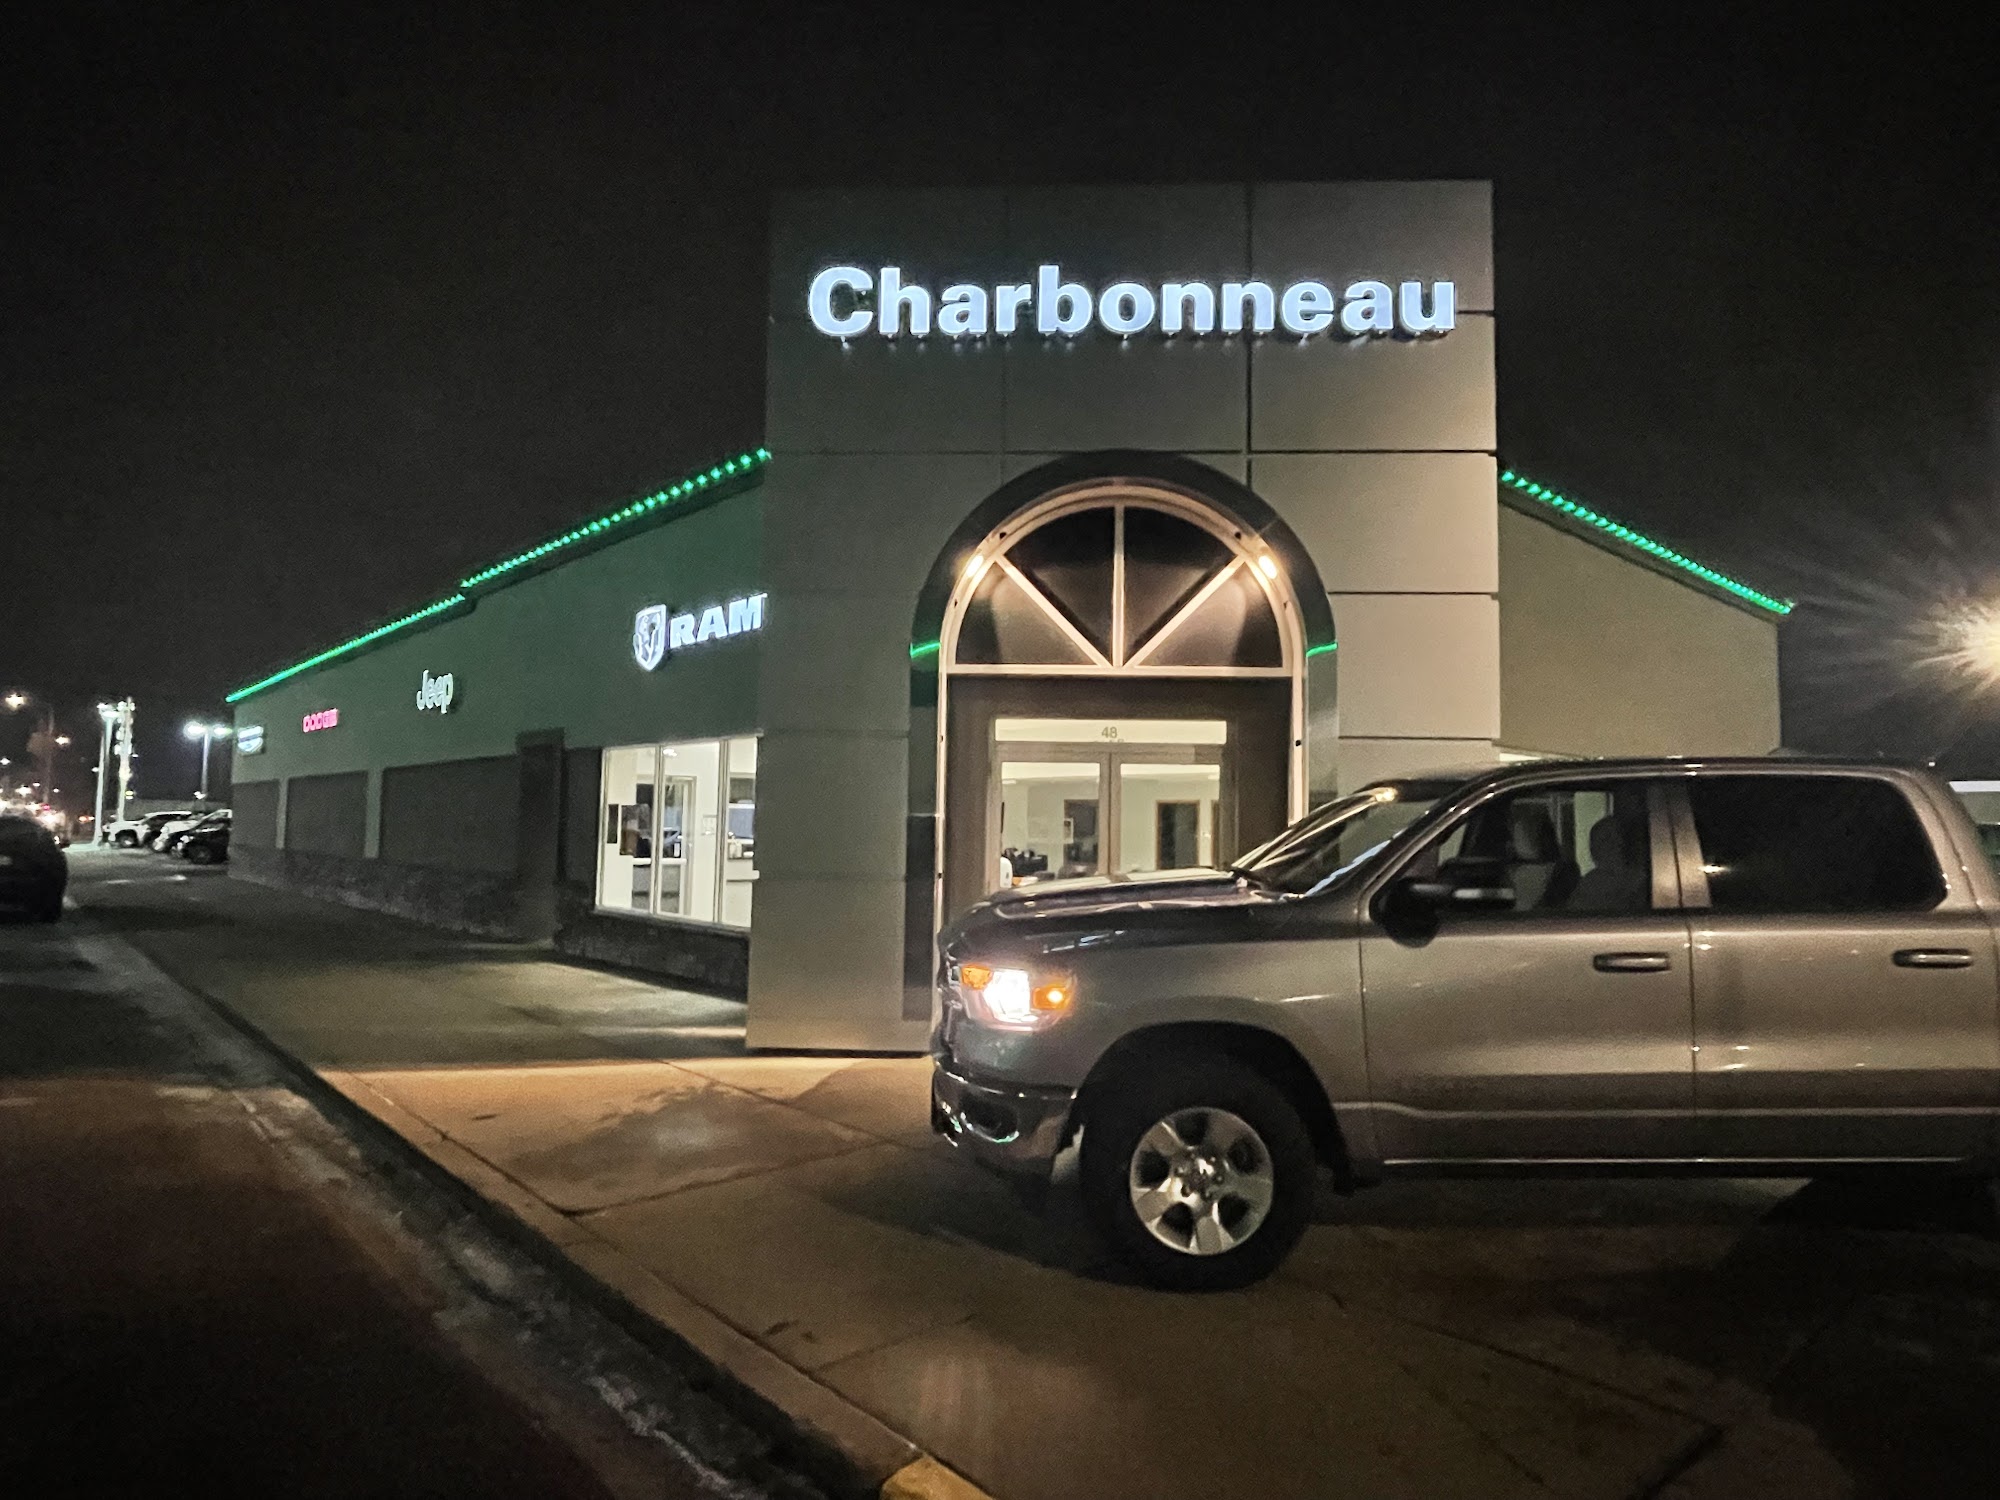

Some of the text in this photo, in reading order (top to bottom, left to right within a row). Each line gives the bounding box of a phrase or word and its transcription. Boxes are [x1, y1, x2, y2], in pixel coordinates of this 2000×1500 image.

[807, 264, 1457, 337] Charbonneau
[669, 592, 768, 649] RAM
[416, 669, 454, 714] Jeep
[1101, 726, 1118, 739] 48
